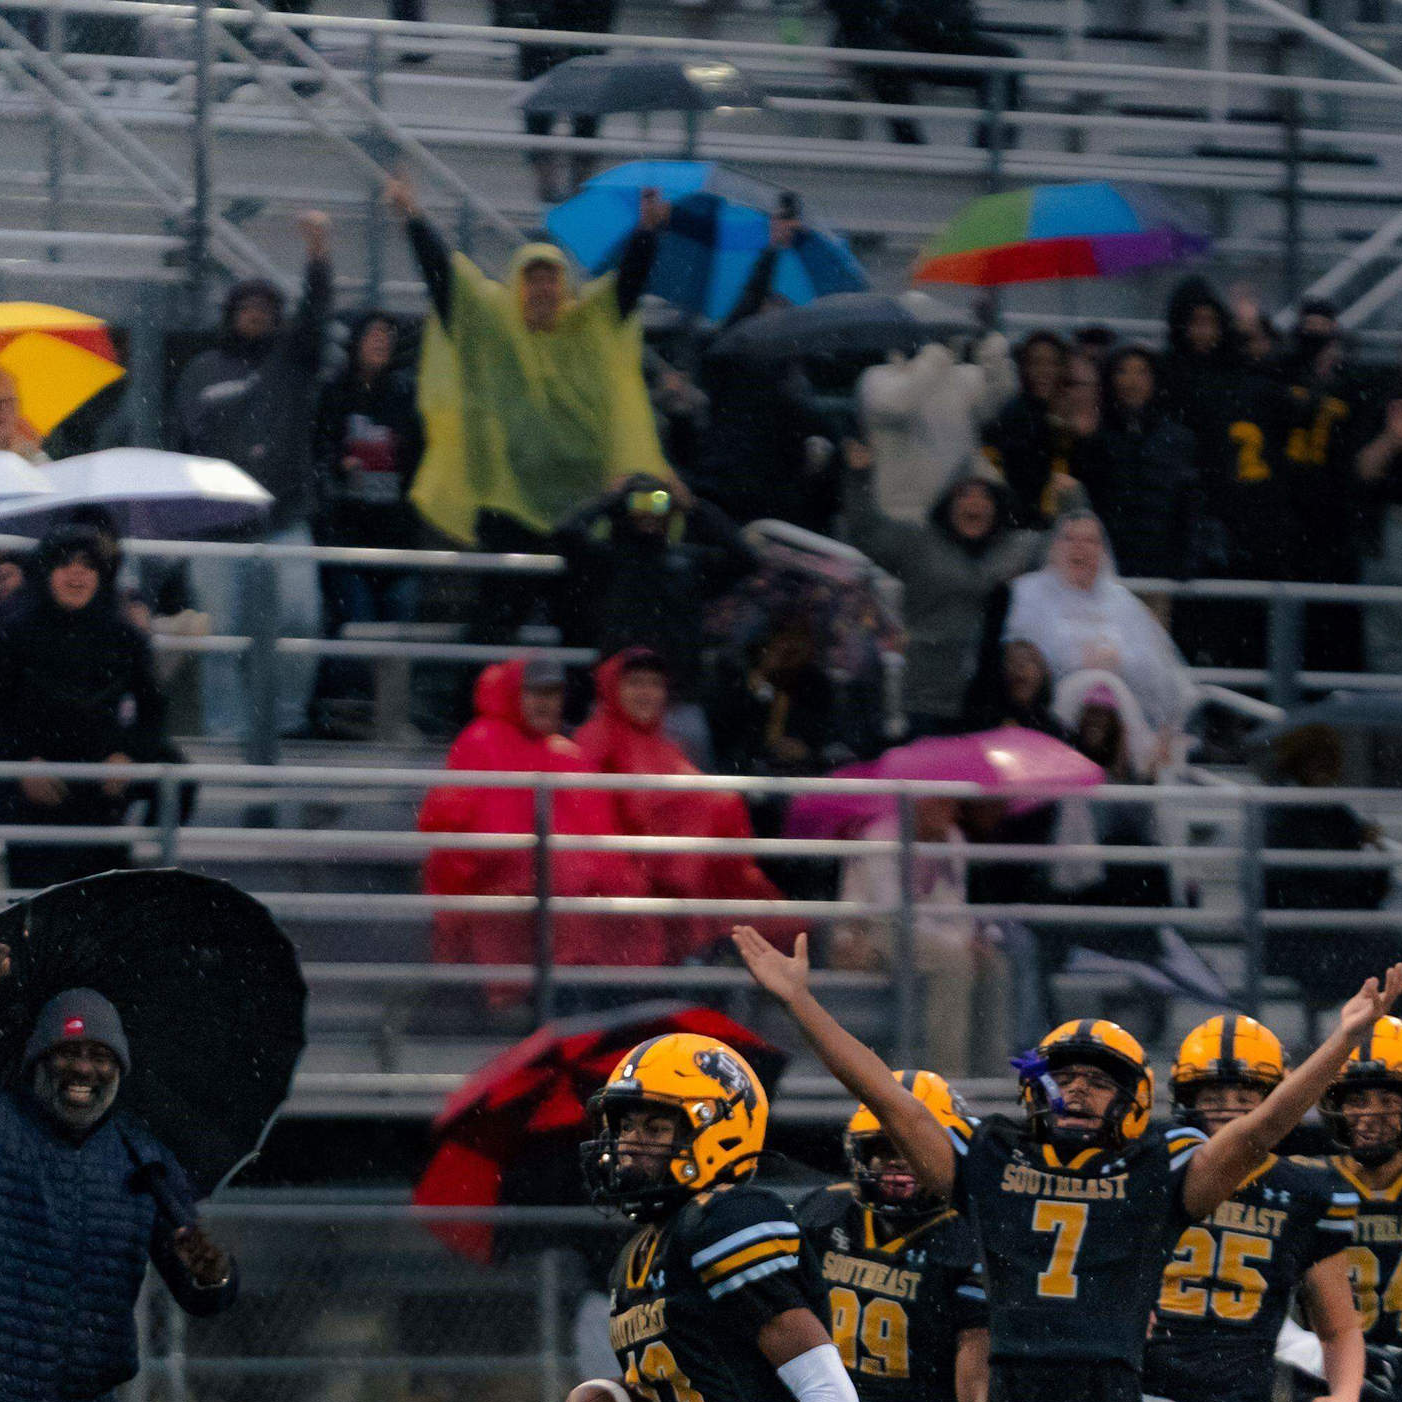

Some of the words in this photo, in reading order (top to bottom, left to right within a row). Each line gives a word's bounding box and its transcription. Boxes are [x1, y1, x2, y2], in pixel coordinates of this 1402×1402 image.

[1001, 1163, 1130, 1200] SOUTHEAST
[1202, 1200, 1289, 1237] HEAST
[1031, 1199, 1090, 1299] 7
[1157, 1226, 1274, 1321] 25
[821, 1251, 923, 1300] SOUTHEAST
